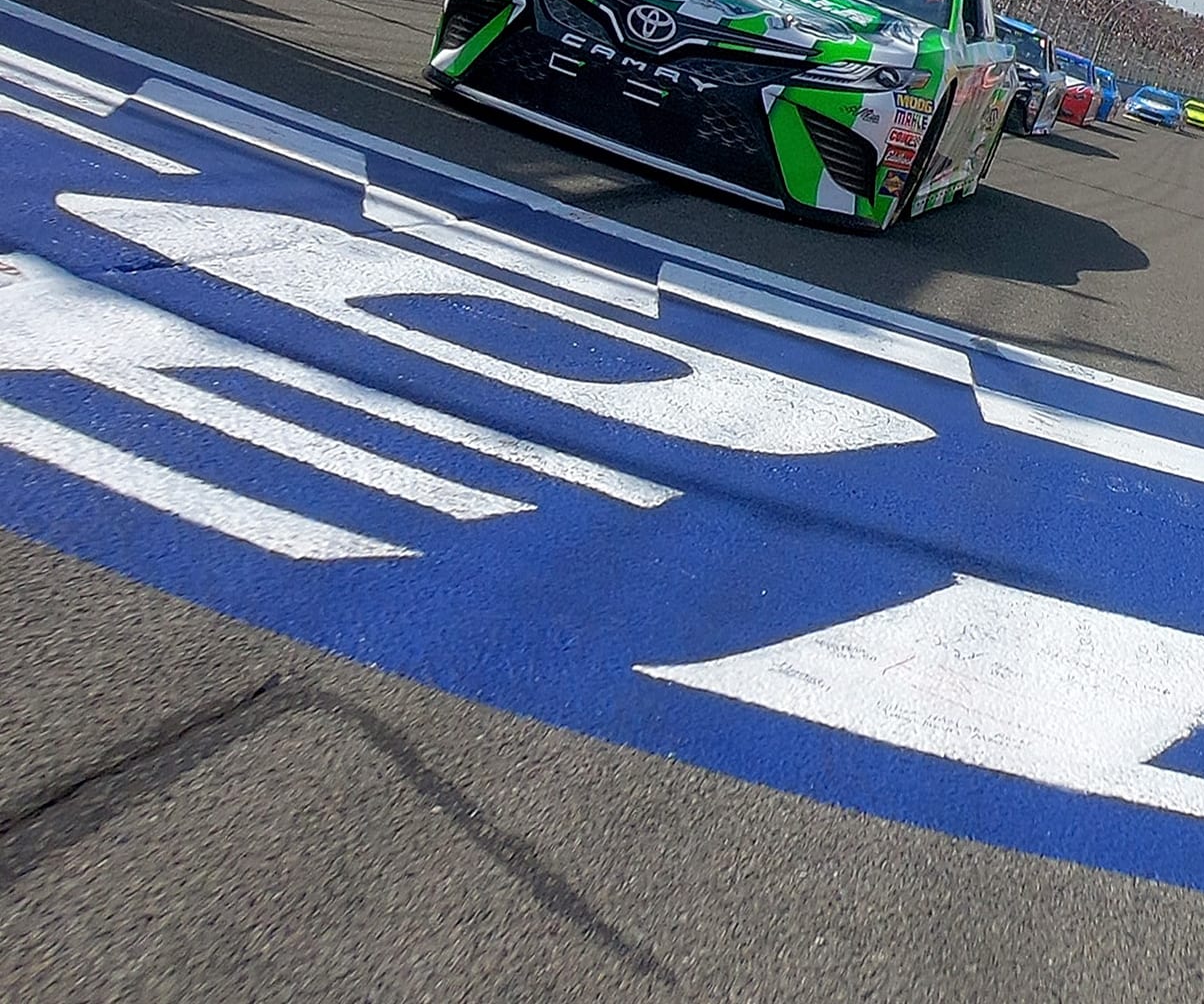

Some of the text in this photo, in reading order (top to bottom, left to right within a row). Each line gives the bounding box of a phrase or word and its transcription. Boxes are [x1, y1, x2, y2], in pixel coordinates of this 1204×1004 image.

[560, 32, 719, 93] CAMRY
[897, 94, 933, 115] MOOG
[894, 110, 929, 131] MAHLE
